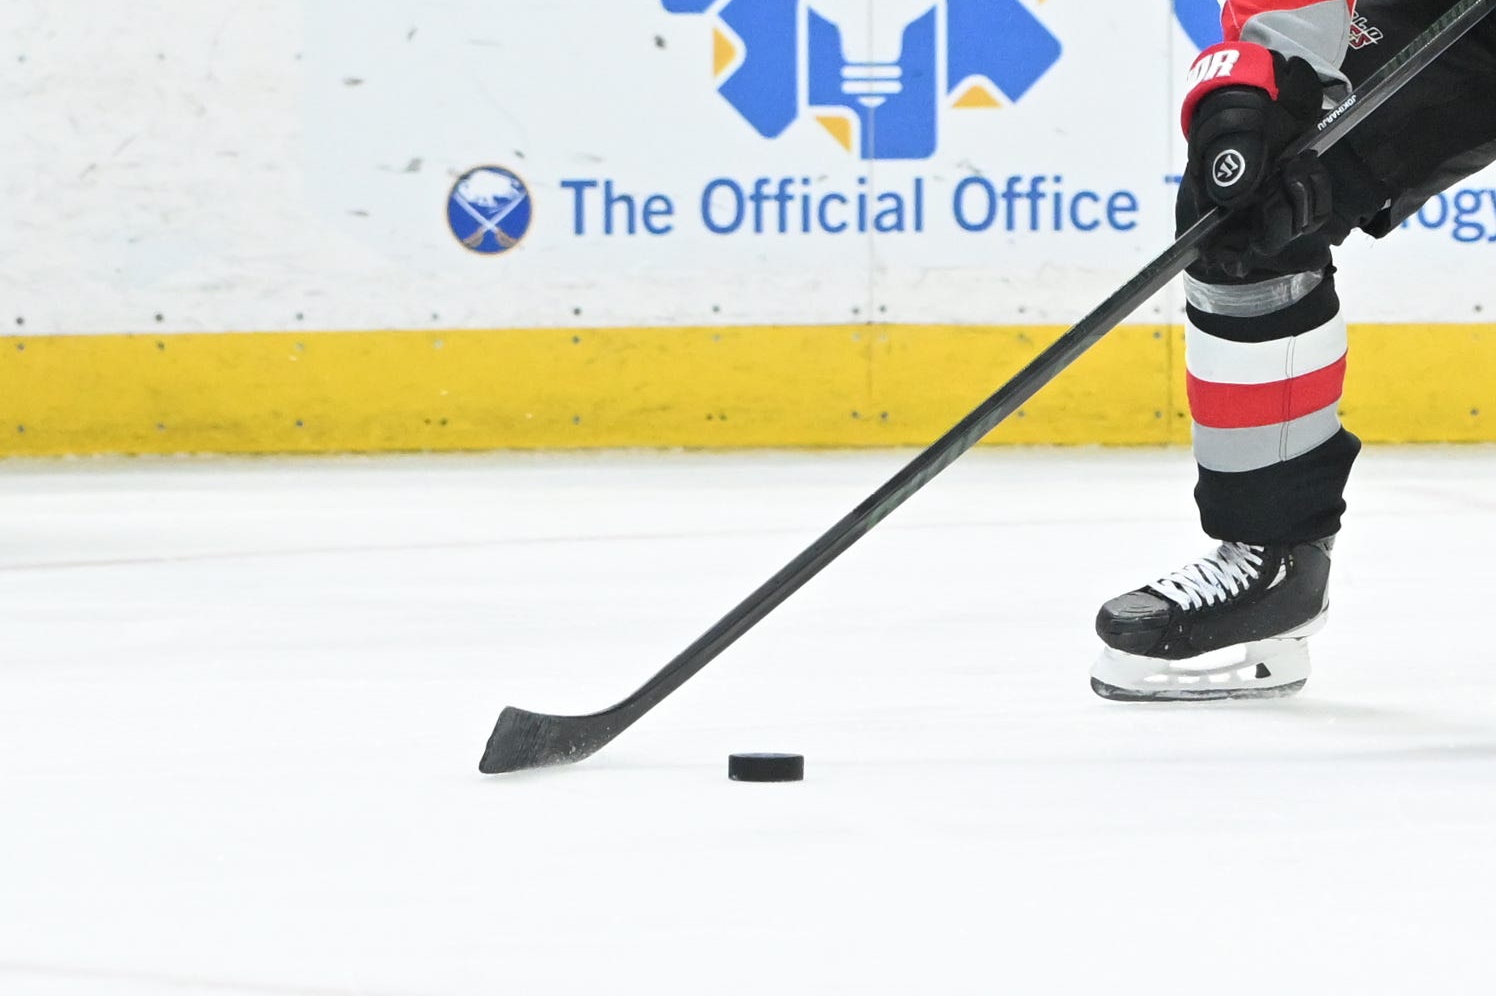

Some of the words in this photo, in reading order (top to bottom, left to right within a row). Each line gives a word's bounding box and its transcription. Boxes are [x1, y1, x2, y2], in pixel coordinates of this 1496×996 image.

[1317, 94, 1357, 131] JOKIHARJU
[558, 176, 676, 236] The
[699, 173, 924, 234] Official
[951, 172, 1140, 233] Office
